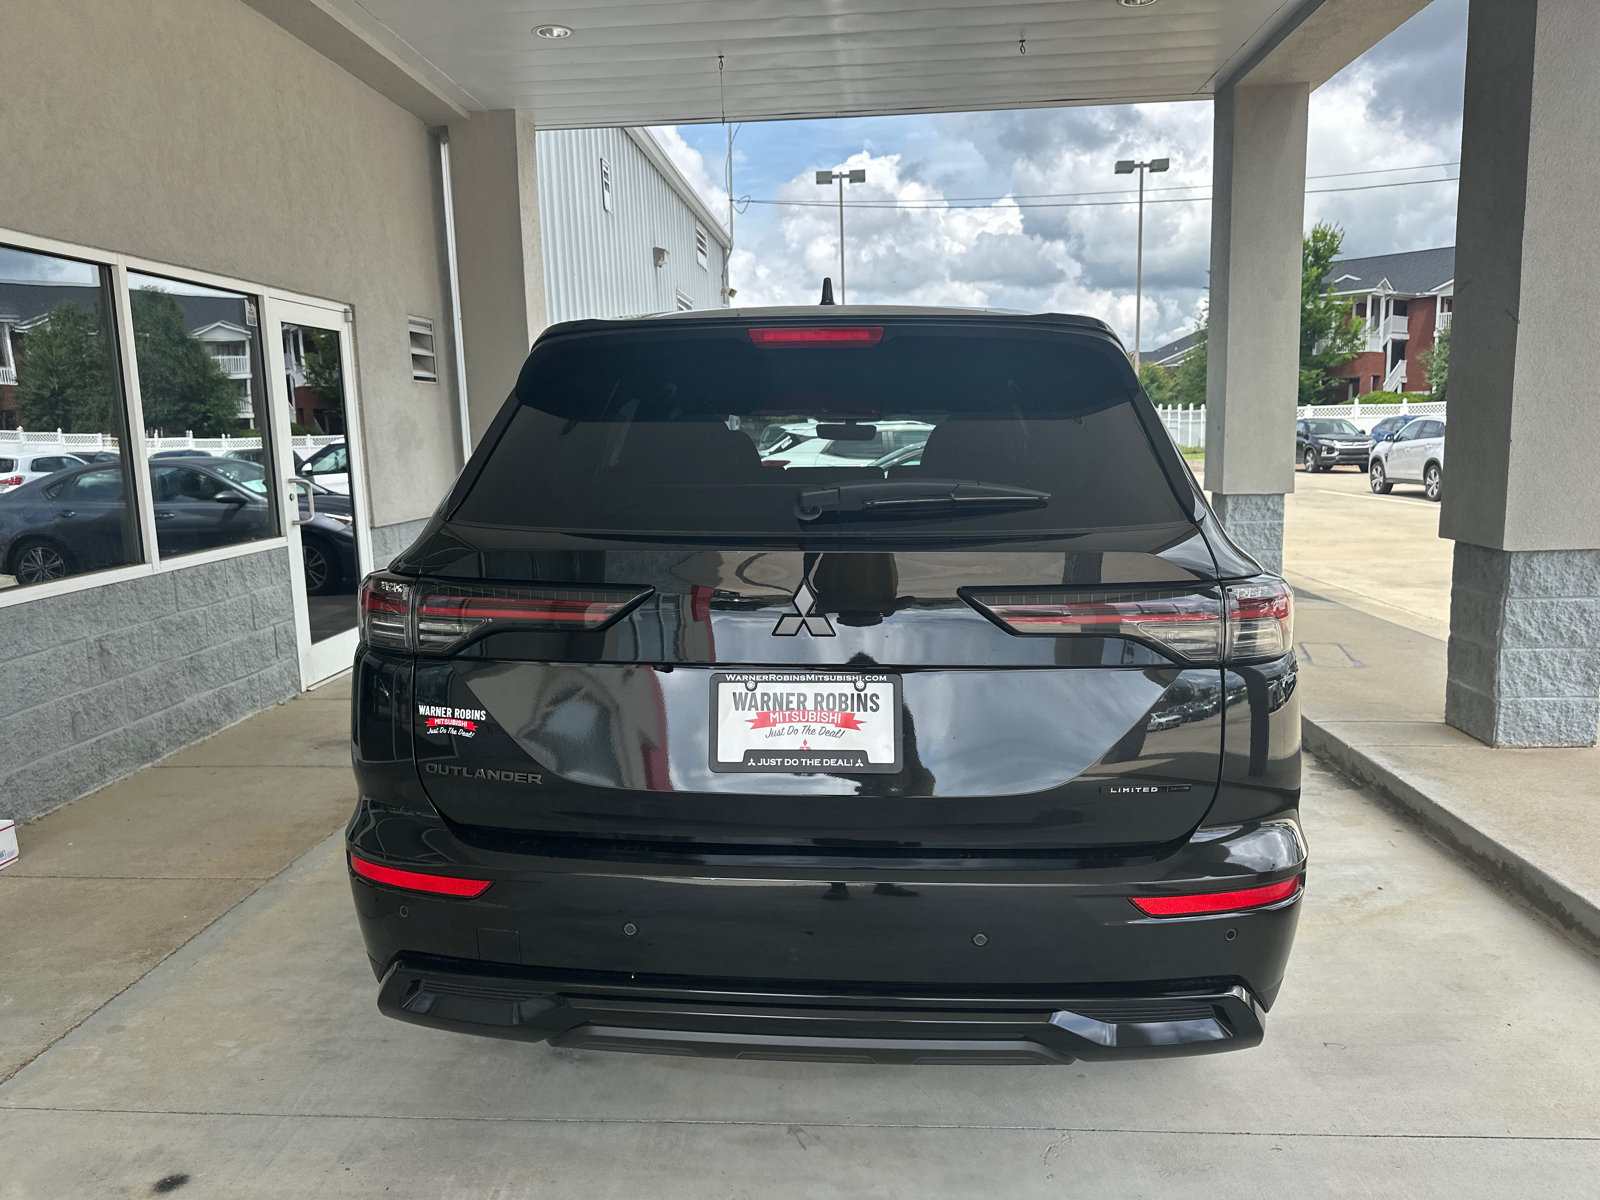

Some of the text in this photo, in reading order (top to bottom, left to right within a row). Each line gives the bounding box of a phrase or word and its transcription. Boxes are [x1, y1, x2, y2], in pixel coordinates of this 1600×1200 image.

[732, 691, 880, 713] WARNER ROBINS
[418, 704, 486, 721] WARNER ROBINS
[769, 711, 842, 724] MITSUBISHI
[434, 718, 468, 728] MITSUBISHI
[427, 727, 439, 735] Just
[440, 726, 447, 734] Do
[448, 727, 457, 735] The
[765, 724, 846, 739] Just Do The Deal!
[757, 758, 853, 767] JUST DO THE DEAL!
[425, 763, 543, 785] OUTLANDER
